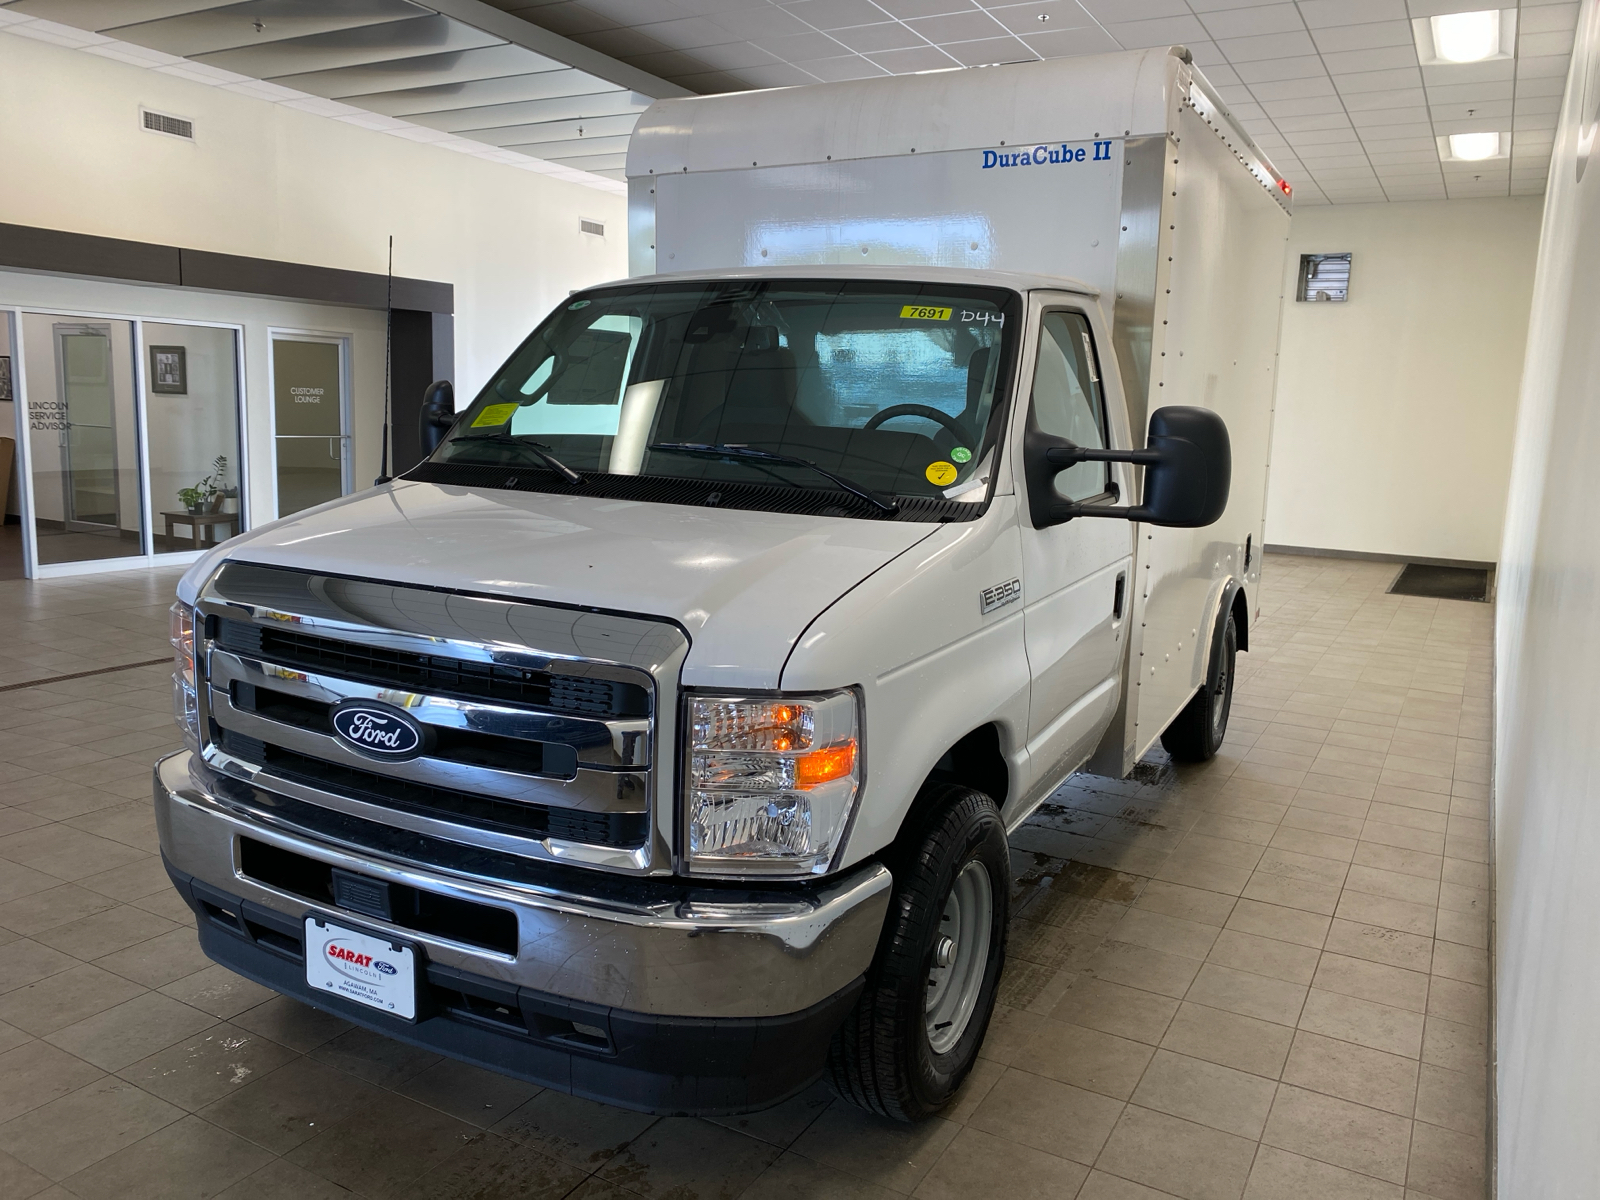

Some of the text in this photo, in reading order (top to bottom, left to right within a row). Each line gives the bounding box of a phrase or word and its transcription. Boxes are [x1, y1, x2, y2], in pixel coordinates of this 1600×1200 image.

[981, 141, 1112, 169] DuraCube II
[909, 307, 945, 319] 7691
[960, 310, 1005, 329] D44
[290, 387, 324, 395] CUSTOMER
[28, 402, 68, 410] LINCOLN
[29, 412, 66, 420] SERVICE
[31, 421, 72, 430] ADVISOR
[349, 713, 401, 747] Ford
[328, 944, 373, 968] SARAT
[348, 965, 377, 978] LINCOLN
[377, 962, 394, 974] Ford
[369, 988, 378, 996] MA
